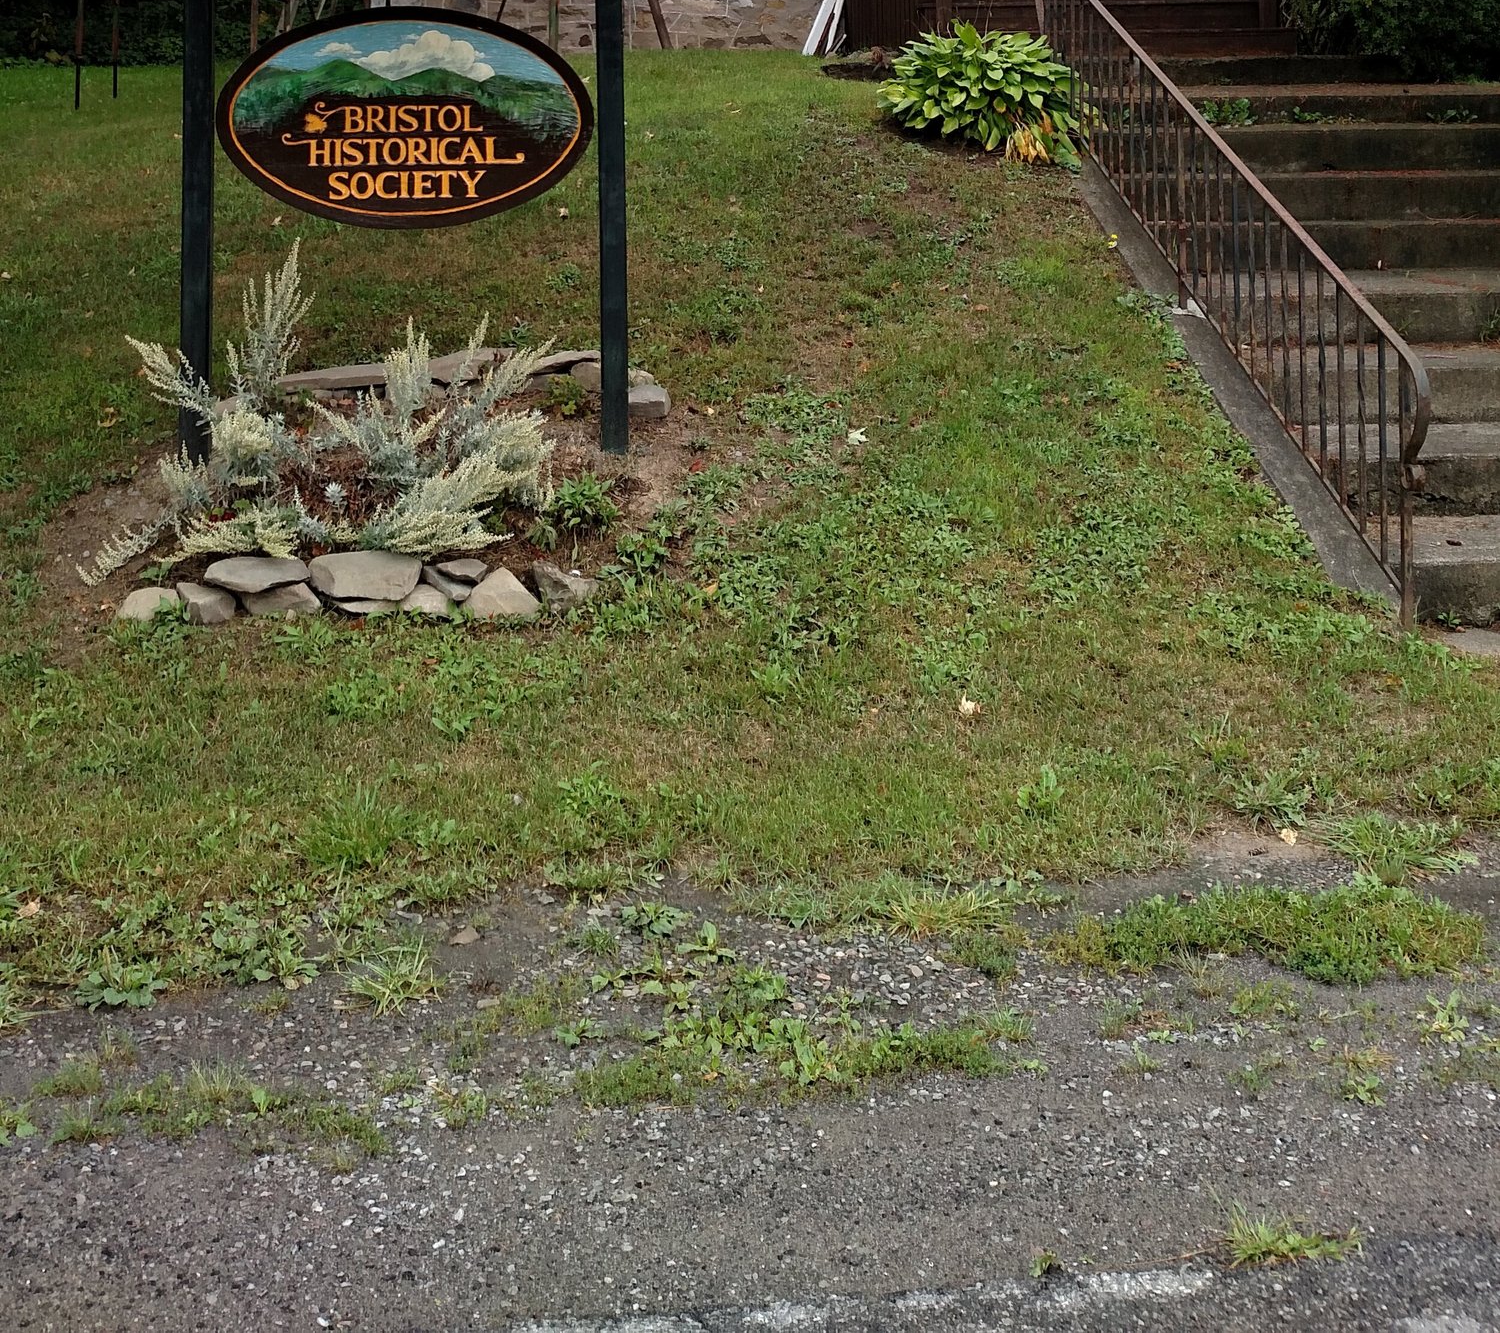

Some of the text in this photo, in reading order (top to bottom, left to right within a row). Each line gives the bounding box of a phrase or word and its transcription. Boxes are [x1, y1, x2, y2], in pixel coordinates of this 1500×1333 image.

[342, 105, 484, 133] BRISTOL
[282, 133, 525, 167] HISTORICAL
[328, 169, 487, 201] SOCIETY
